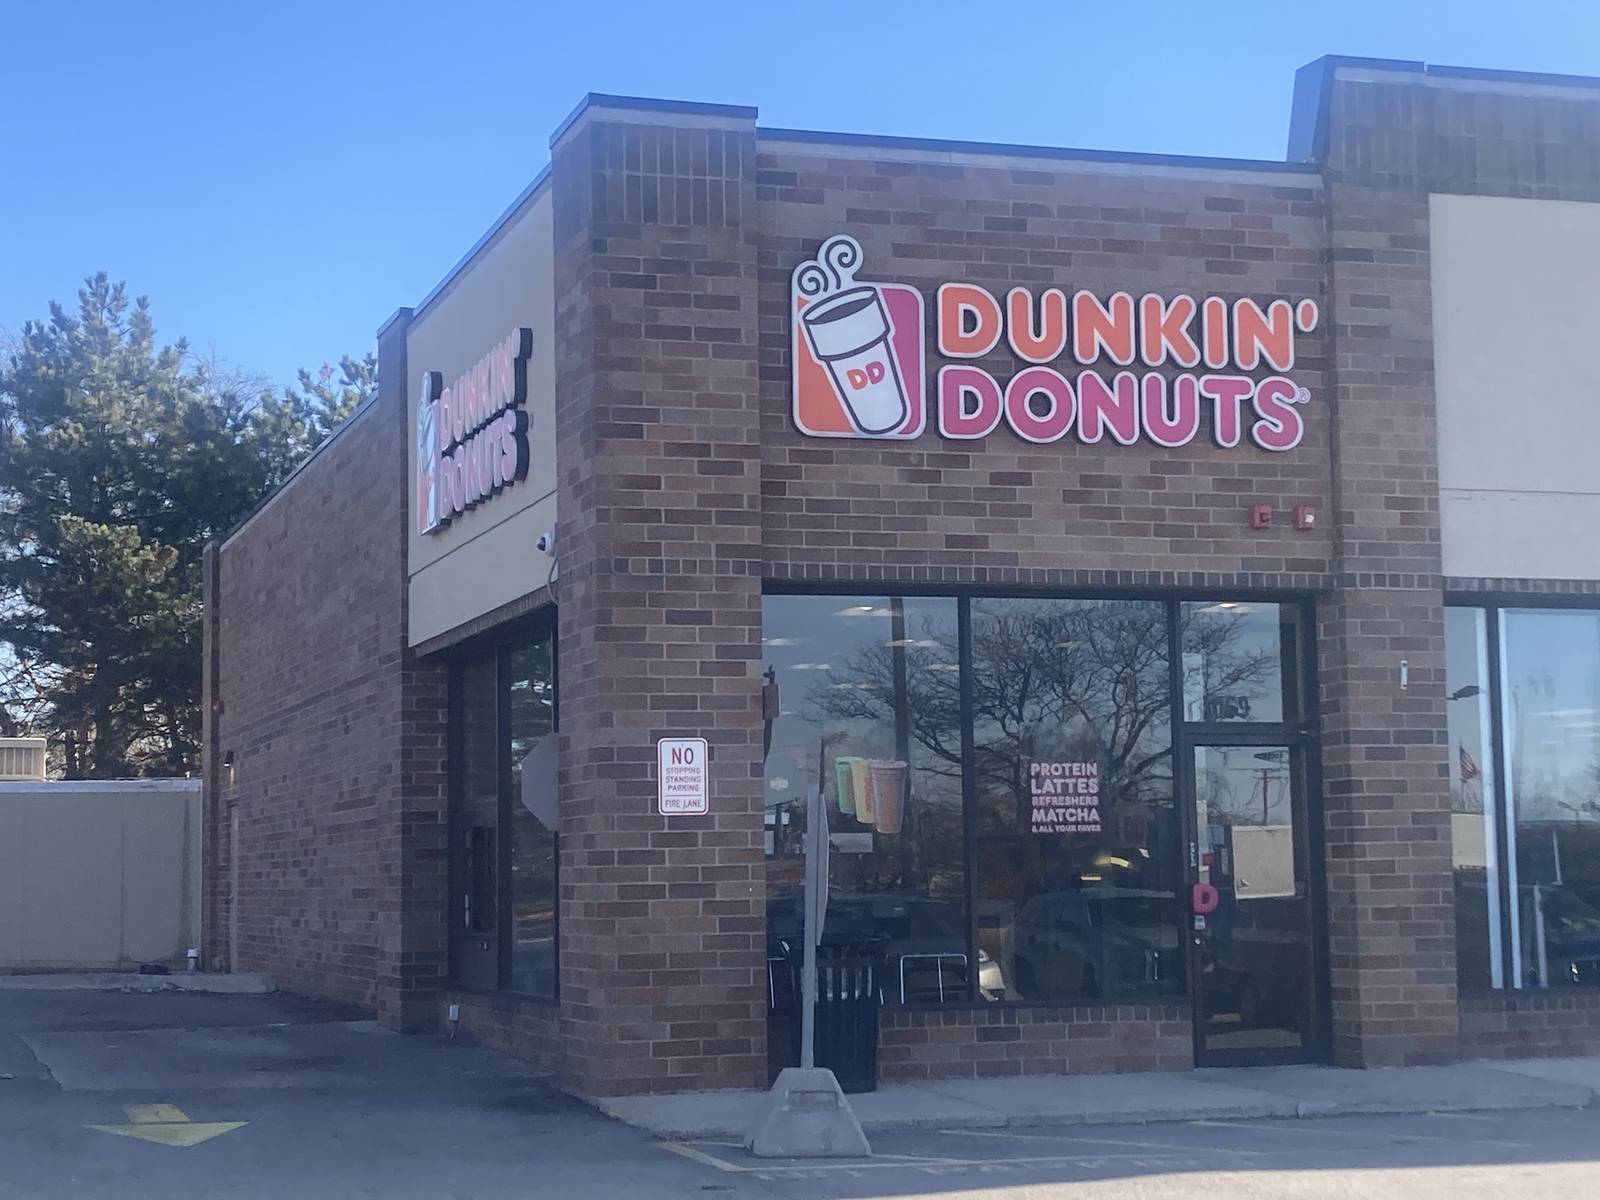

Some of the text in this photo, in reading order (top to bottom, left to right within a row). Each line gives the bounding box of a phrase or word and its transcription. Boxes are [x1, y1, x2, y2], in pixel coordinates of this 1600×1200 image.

[937, 282, 1318, 372] DUNKIN'
[847, 361, 885, 390] DD
[671, 747, 694, 765] NO
[665, 767, 701, 775] STOPPING
[1031, 762, 1098, 776] PROTEIN
[665, 775, 701, 783] STANDING
[667, 784, 699, 792] PARKING
[1031, 778, 1099, 794] LATTES
[665, 799, 702, 809] FIRE LANE
[1032, 796, 1099, 807] REFRESHERS
[1032, 807, 1100, 822] MATCHA
[1039, 825, 1054, 833] ALL
[1055, 824, 1077, 832] YOUR
